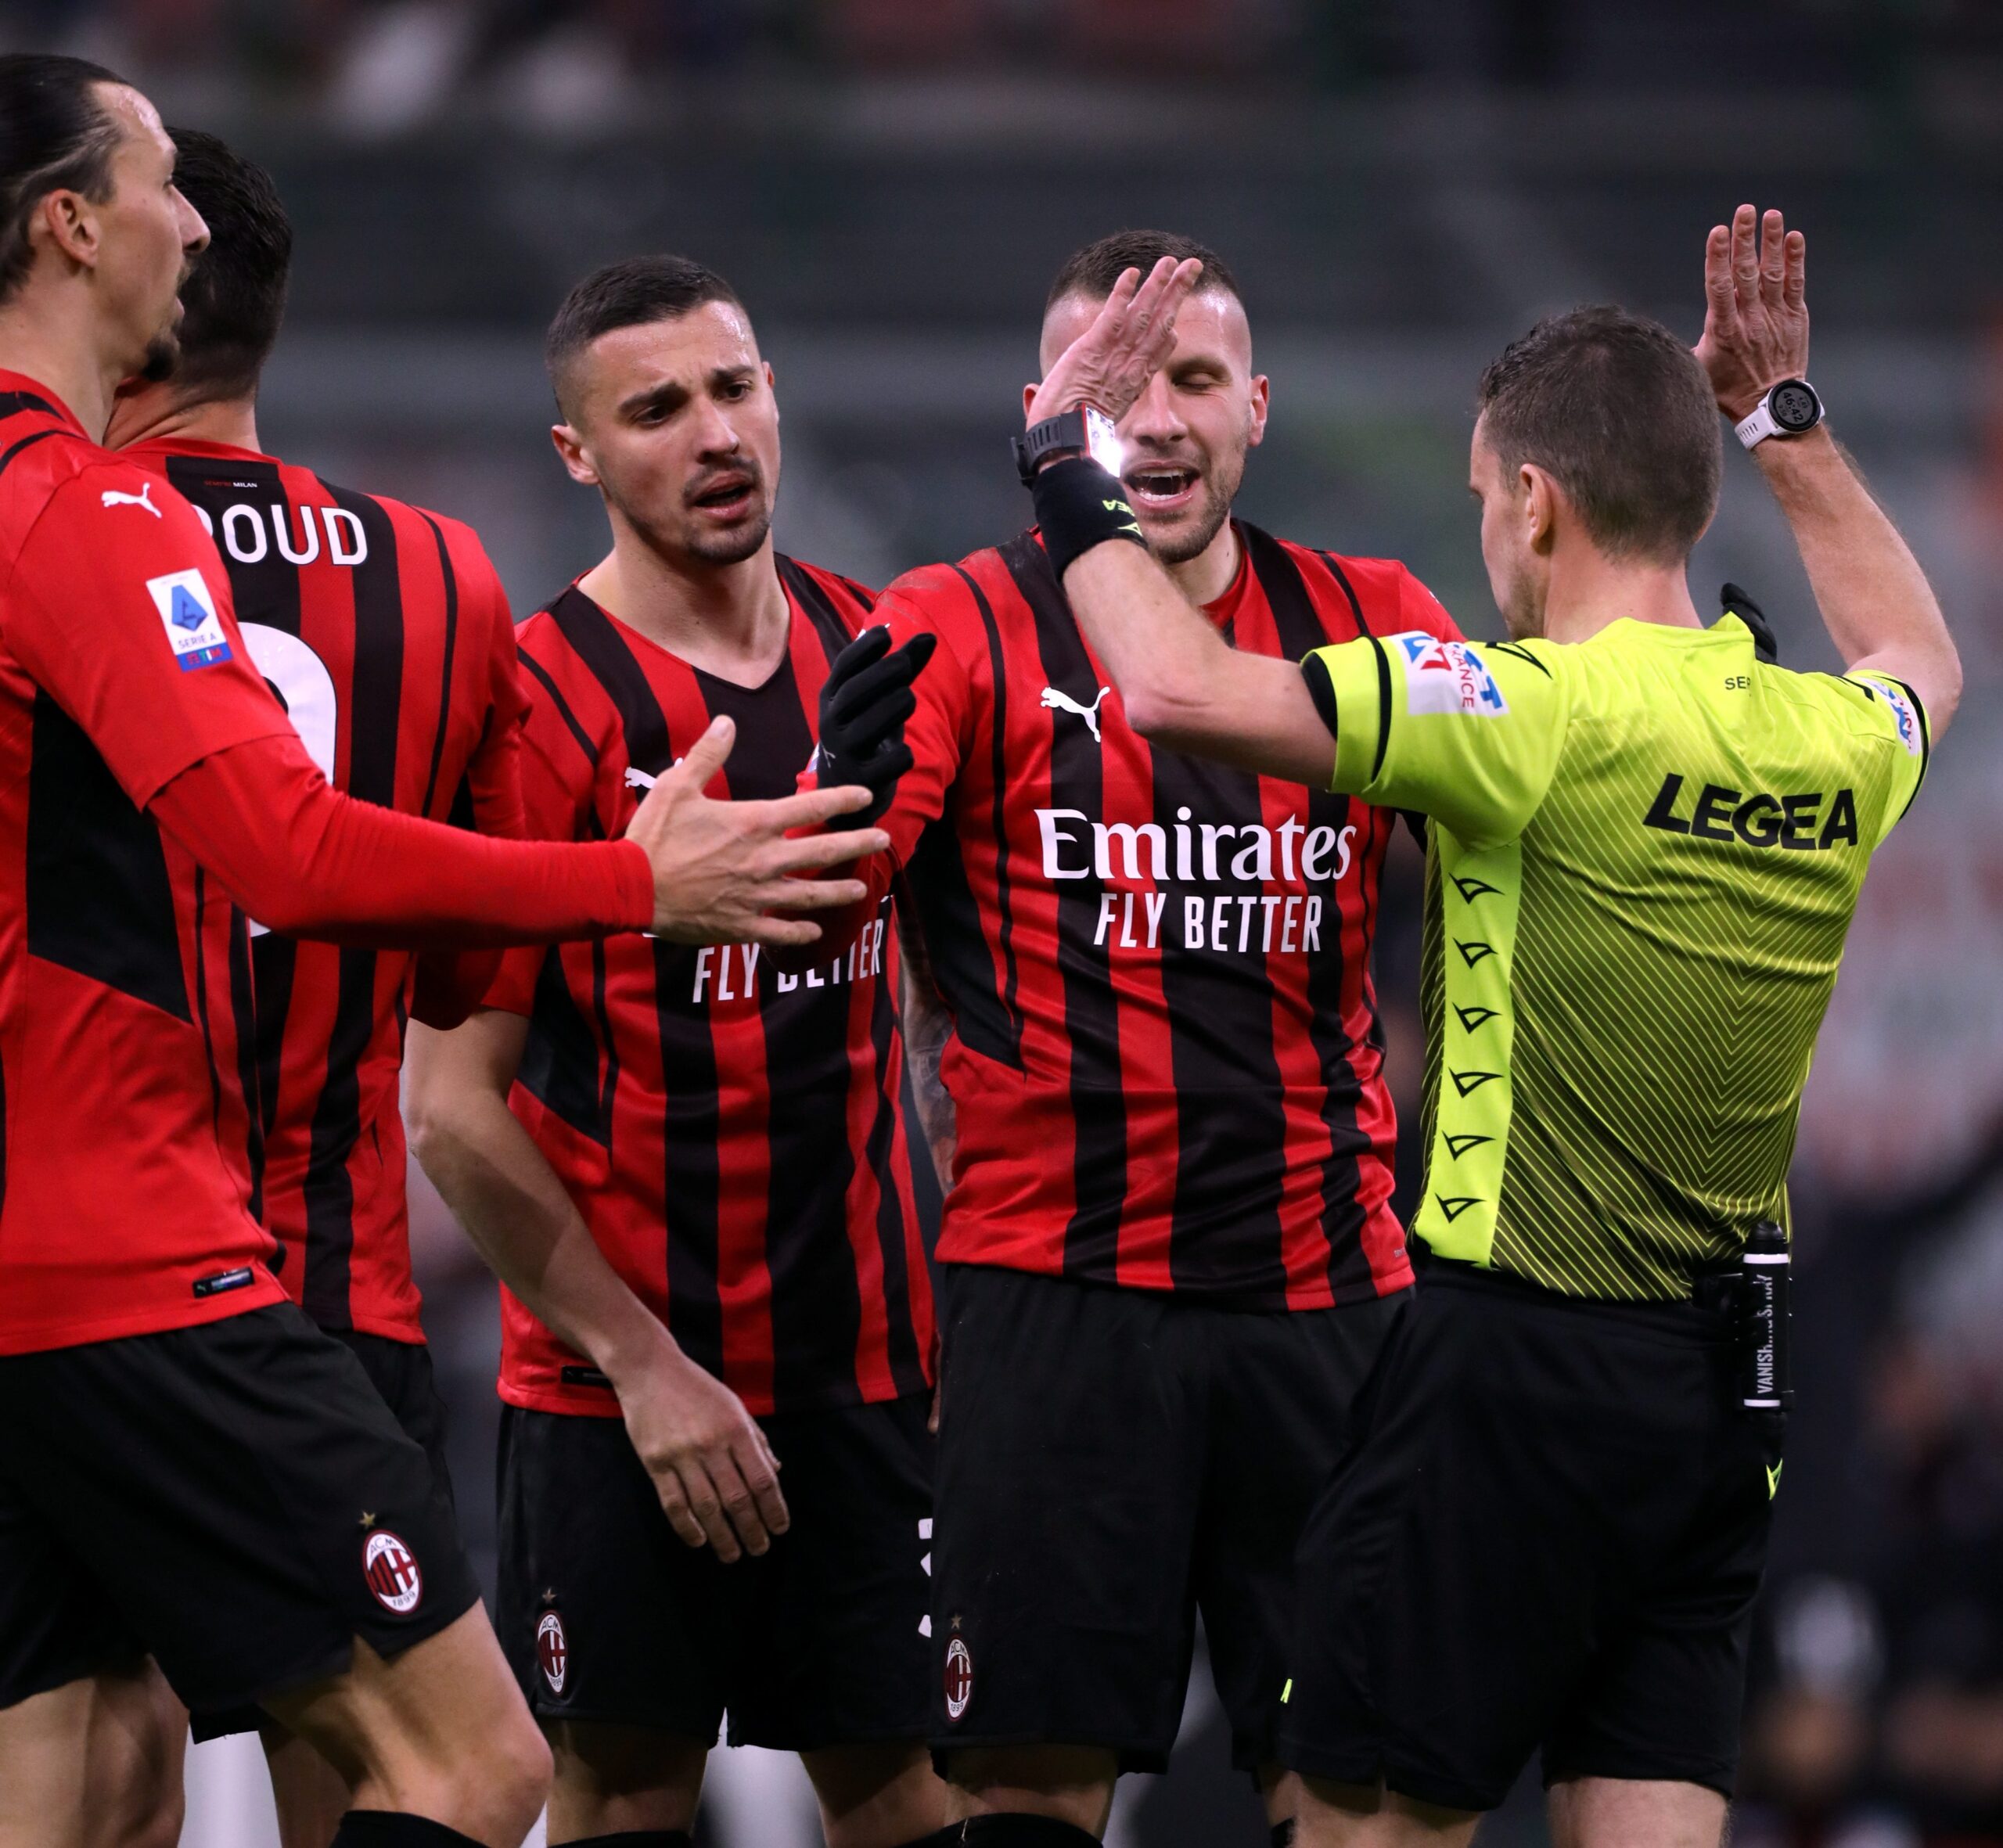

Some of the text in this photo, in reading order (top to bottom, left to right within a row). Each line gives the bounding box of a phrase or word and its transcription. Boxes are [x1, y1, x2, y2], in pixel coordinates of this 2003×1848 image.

[178, 632, 217, 649] SERIE A
[1642, 772, 1858, 850] LEGEA
[1034, 807, 1357, 881] Emirates
[1094, 893, 1322, 953] FLY BETTER
[692, 942, 761, 1003] FLY
[392, 1591, 415, 1607] 1899
[540, 1616, 559, 1632] ACM
[950, 1641, 967, 1657] ACM
